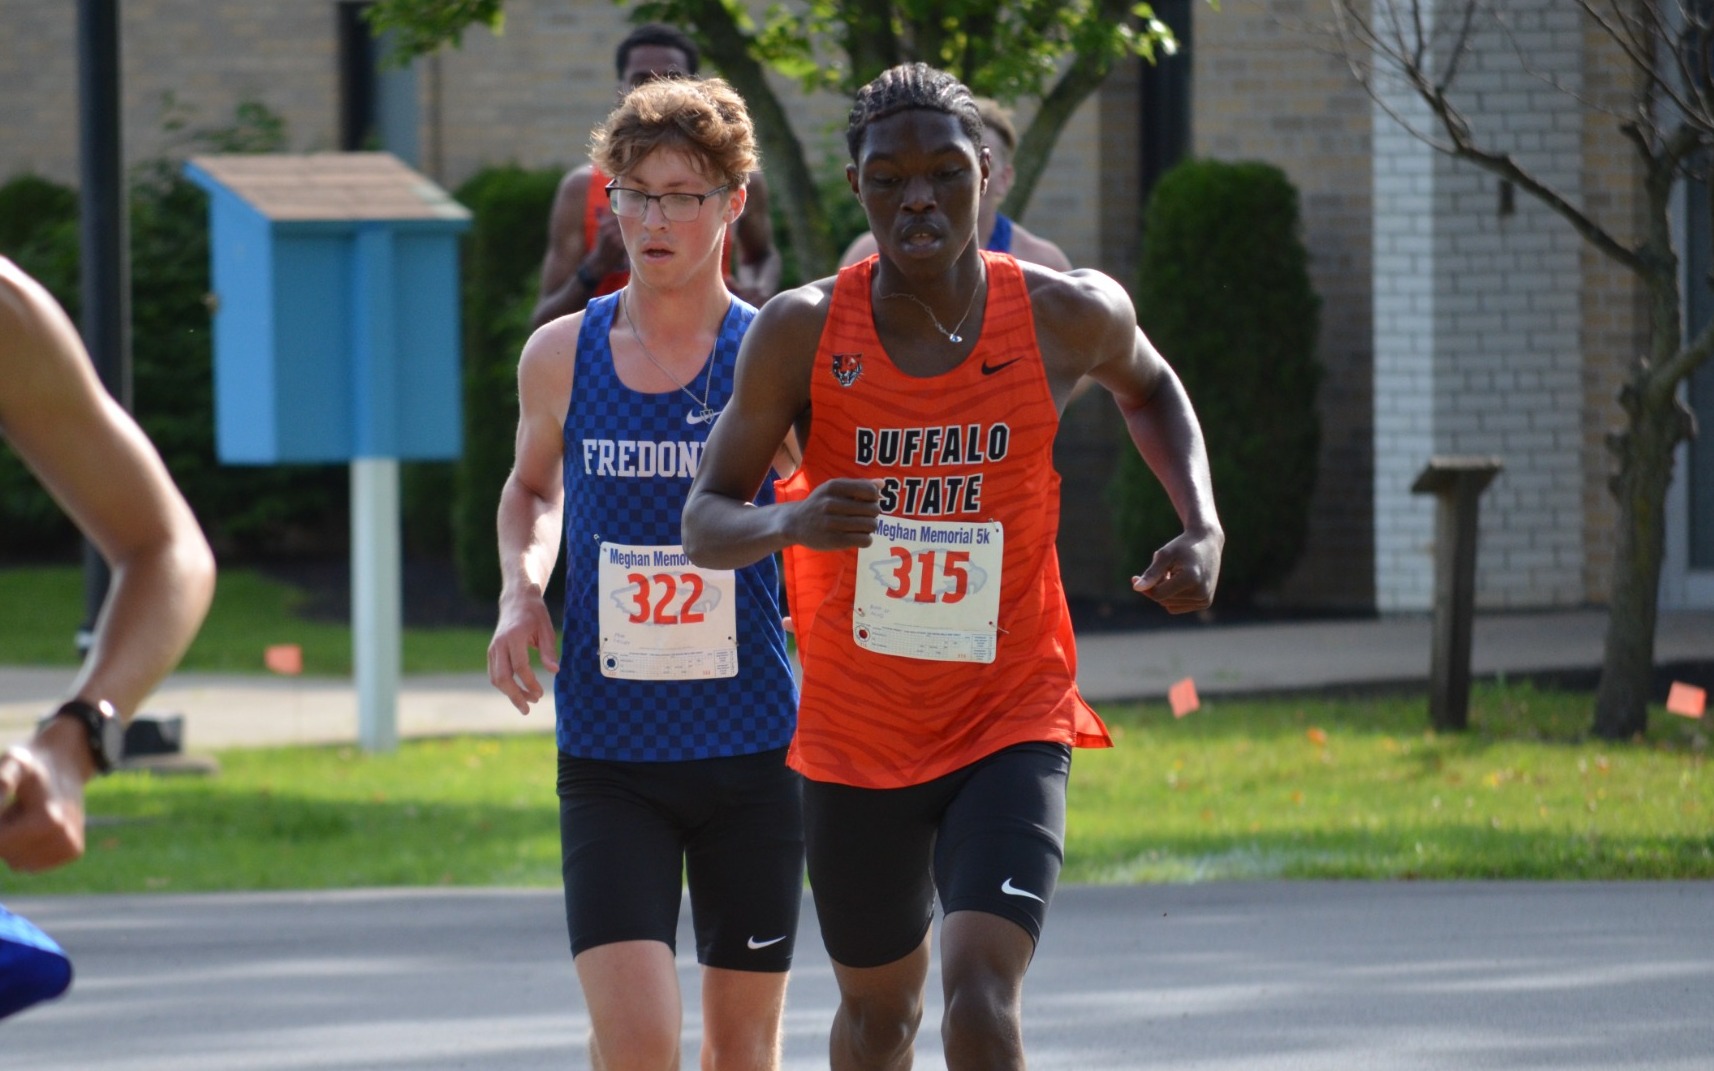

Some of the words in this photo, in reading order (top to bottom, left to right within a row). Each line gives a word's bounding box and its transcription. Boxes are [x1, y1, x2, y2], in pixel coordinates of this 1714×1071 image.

[855, 422, 1010, 466] BUFFALO
[879, 473, 983, 516] STATE
[874, 519, 917, 541] Meghan
[919, 526, 973, 544] Memorial
[976, 528, 990, 544] 5k
[609, 548, 650, 569] Meghan
[886, 546, 970, 604] 315
[627, 573, 705, 625] 322
